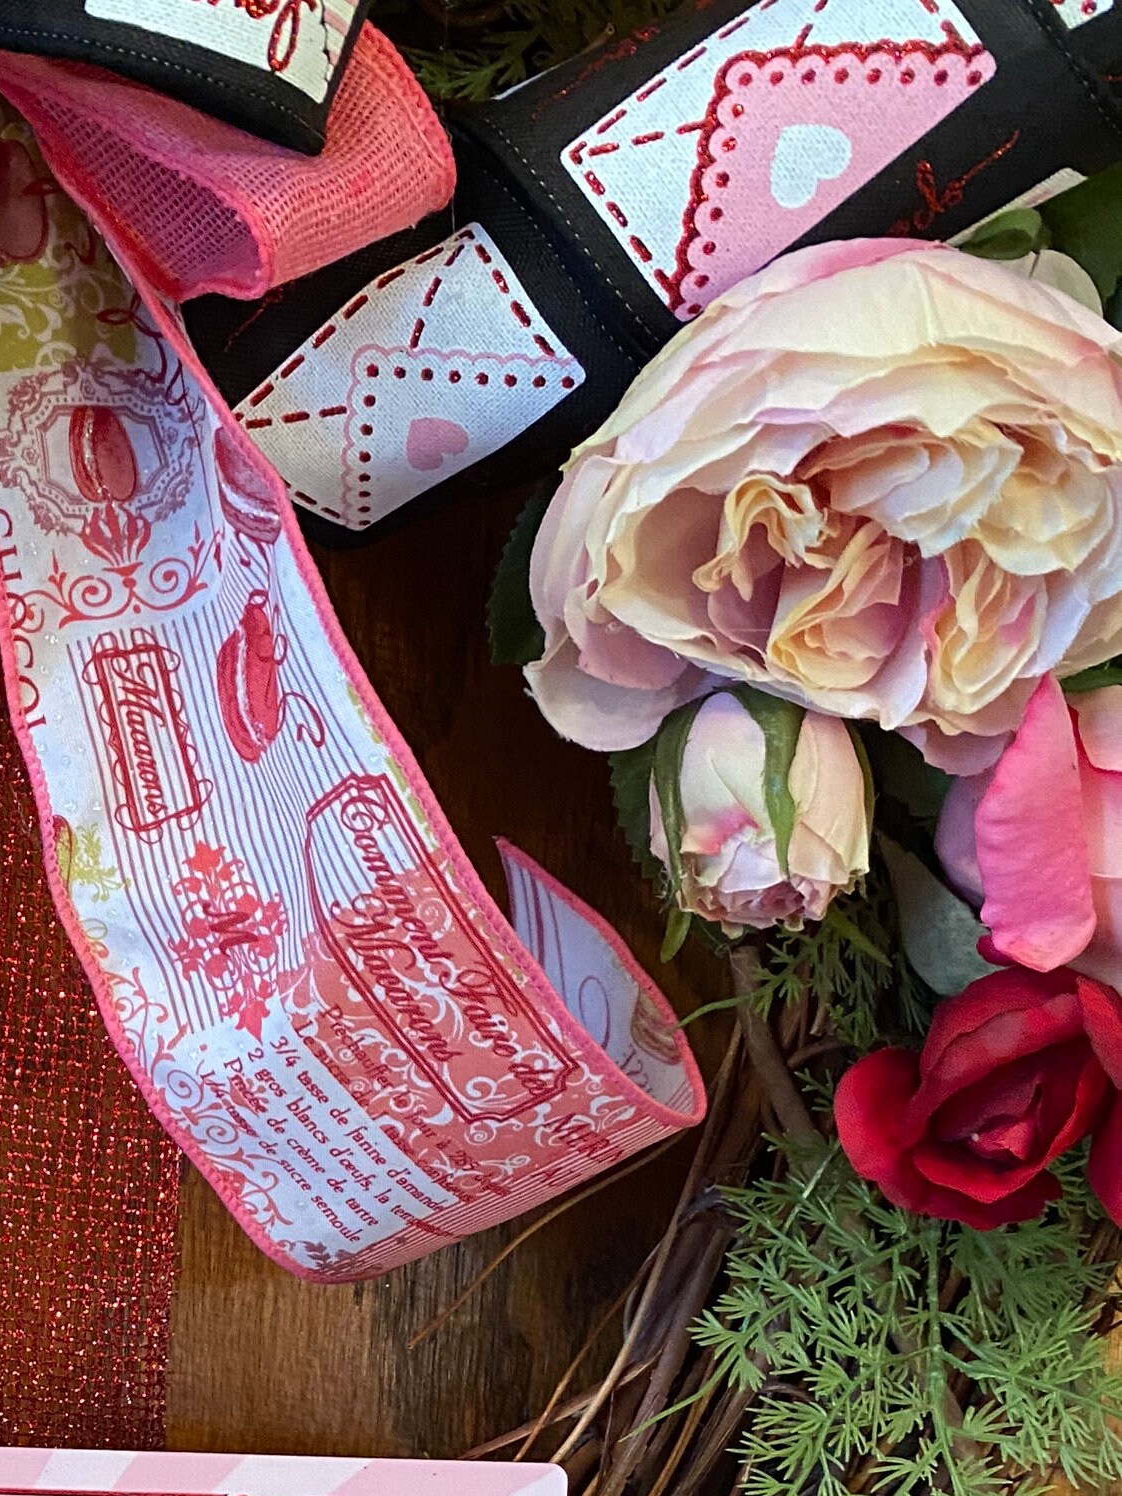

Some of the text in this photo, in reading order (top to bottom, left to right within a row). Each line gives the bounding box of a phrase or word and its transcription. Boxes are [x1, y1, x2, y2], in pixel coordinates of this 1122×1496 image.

[112, 656, 168, 815] Macarons
[331, 892, 462, 1064] Macarons
[341, 786, 551, 1098] Comment Faire des
[245, 1047, 264, 1064] 2
[253, 1068, 287, 1098] gros
[268, 1035, 296, 1068] 3/4
[296, 1070, 329, 1105] tasse
[328, 1106, 349, 1128] de
[345, 1128, 387, 1167] farine
[293, 1018, 319, 1048] Le
[313, 1046, 354, 1089] sucre
[350, 1094, 371, 1111] de
[382, 1125, 418, 1157] tasse
[390, 1089, 410, 1110] le
[400, 1112, 439, 1141] four
[199, 1071, 362, 1244] 1/4 tasse de sucre semoule
[265, 1117, 288, 1136] de
[284, 1136, 326, 1176] crème
[325, 1175, 345, 1195] de
[345, 1196, 379, 1228] tartre
[285, 1097, 329, 1144] blancs
[373, 1189, 389, 1205] la
